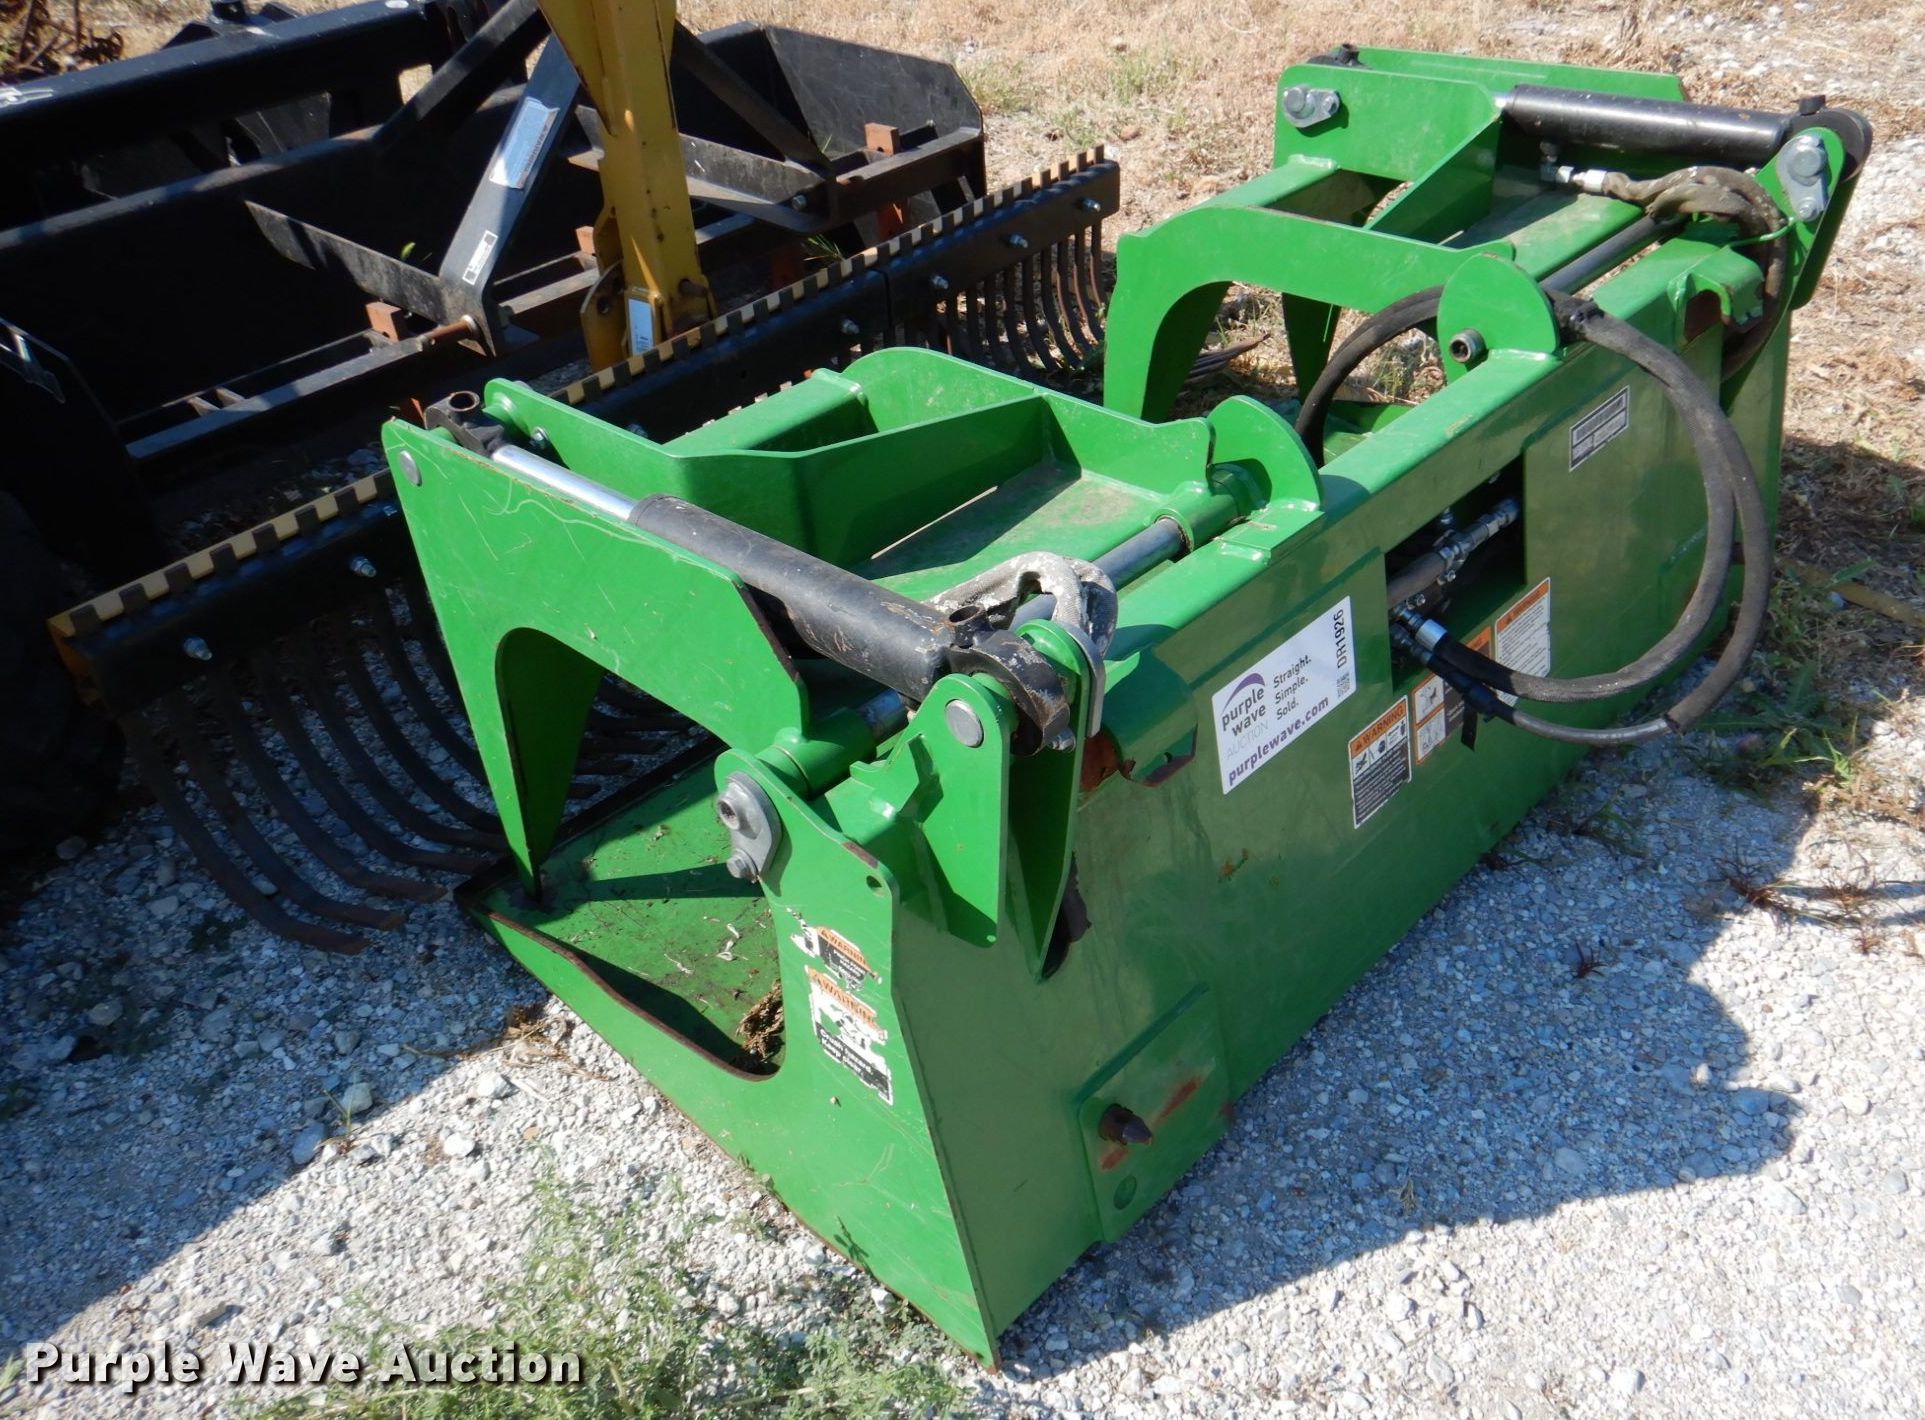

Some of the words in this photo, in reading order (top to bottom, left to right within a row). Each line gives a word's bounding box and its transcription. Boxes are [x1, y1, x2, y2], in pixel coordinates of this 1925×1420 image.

[1333, 609, 1348, 669] DR1926
[1273, 654, 1311, 689] Straight.
[1275, 676, 1308, 705] Simple.
[1221, 686, 1265, 731] purple
[1231, 704, 1267, 736] wave
[1276, 697, 1299, 720] Sold.
[1362, 704, 1404, 744] WARNING
[1226, 721, 1269, 760] AUCTION
[1228, 697, 1329, 786] purplewave.com
